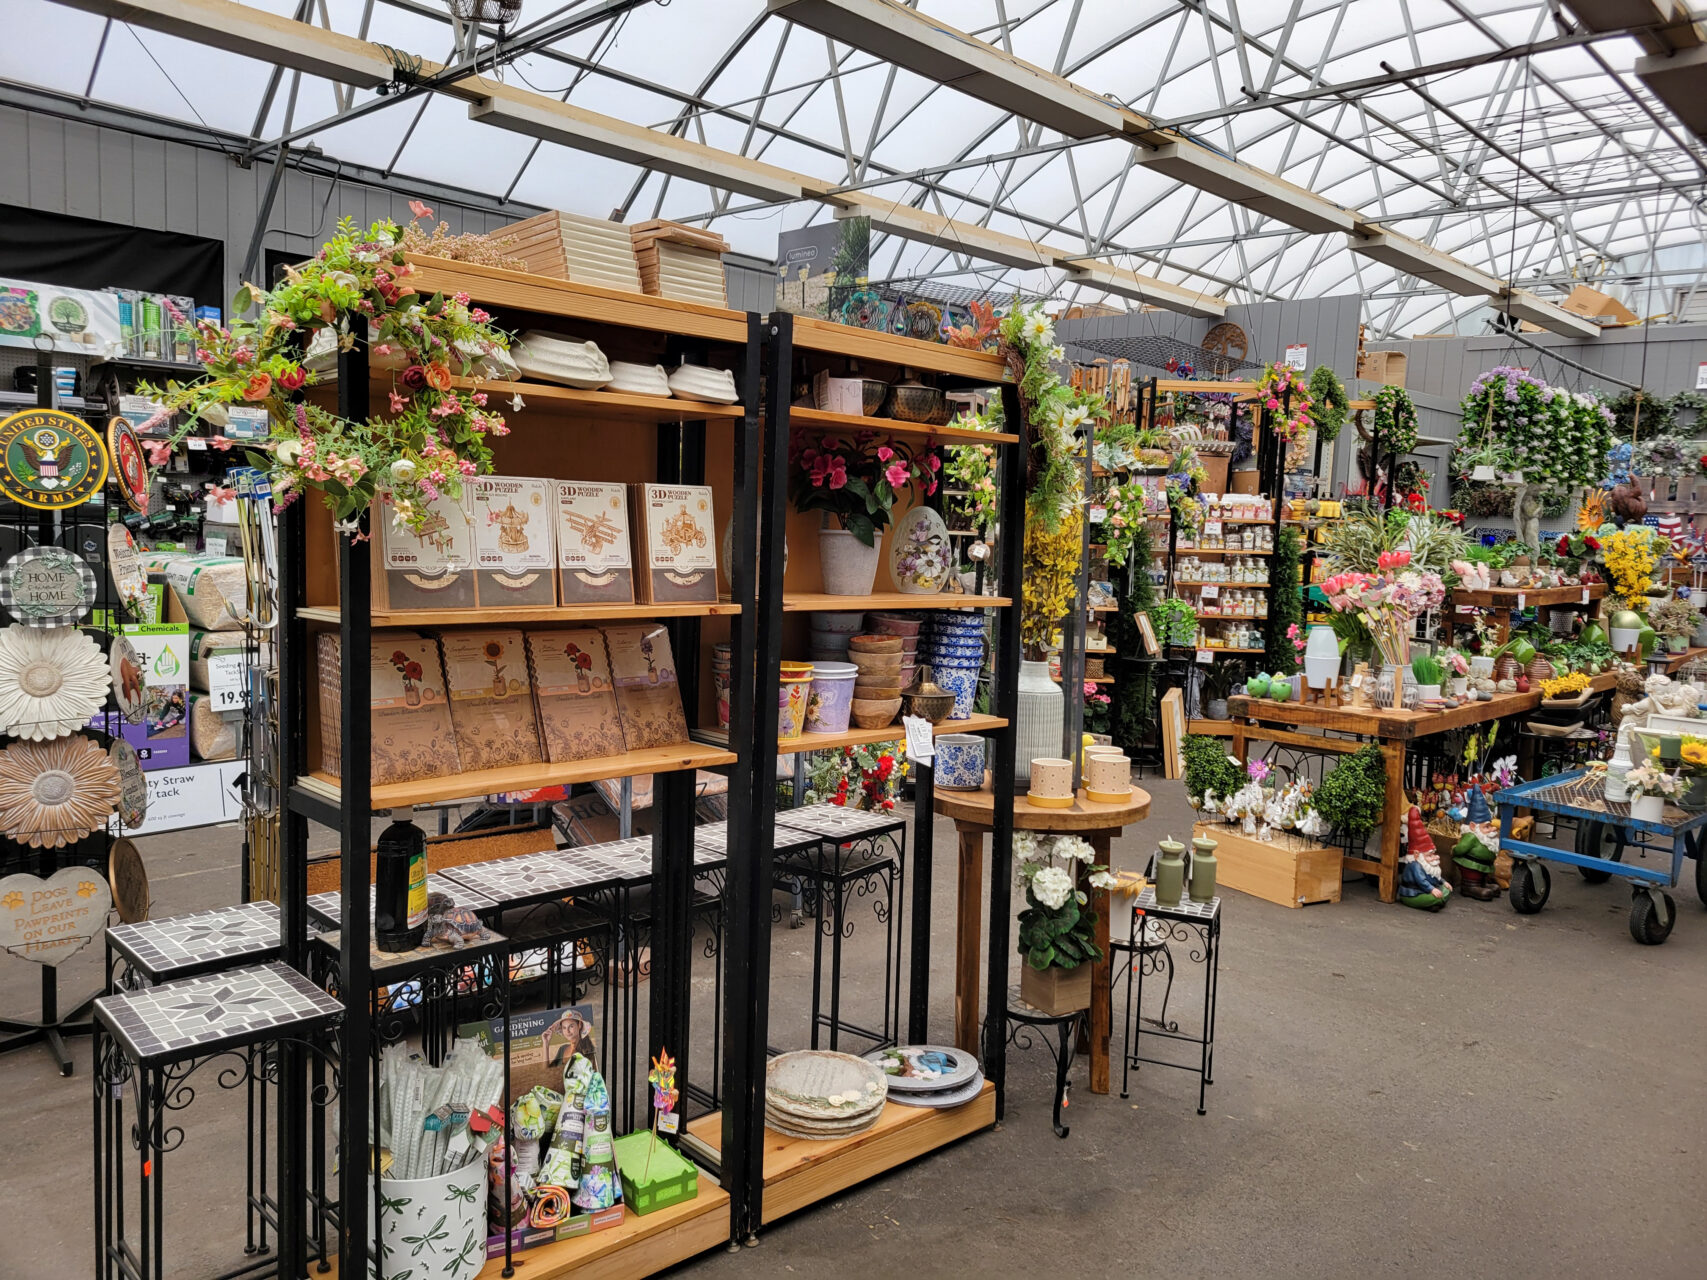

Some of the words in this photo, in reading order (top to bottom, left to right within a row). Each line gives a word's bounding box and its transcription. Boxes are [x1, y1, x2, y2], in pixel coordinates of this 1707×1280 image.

[789, 250, 816, 261] lumineo
[0, 416, 45, 445] UNITED
[48, 416, 96, 448] STATES
[24, 490, 76, 503] ARMY
[560, 486, 577, 497] 3D
[652, 490, 667, 500] 3D
[28, 572, 66, 583] HOME
[30, 591, 68, 602] HOME
[140, 625, 182, 633] Chemicals.
[162, 774, 195, 786] Straw
[156, 788, 181, 799] tack
[31, 887, 68, 902] DOGS
[30, 898, 73, 915] LEAVE
[15, 907, 89, 932] PAWPRINTS
[23, 929, 42, 940] ON
[47, 921, 77, 934] OUR
[26, 934, 81, 954] HEARTS
[494, 1019, 545, 1033] GADENING
[511, 1029, 529, 1037] HAT
